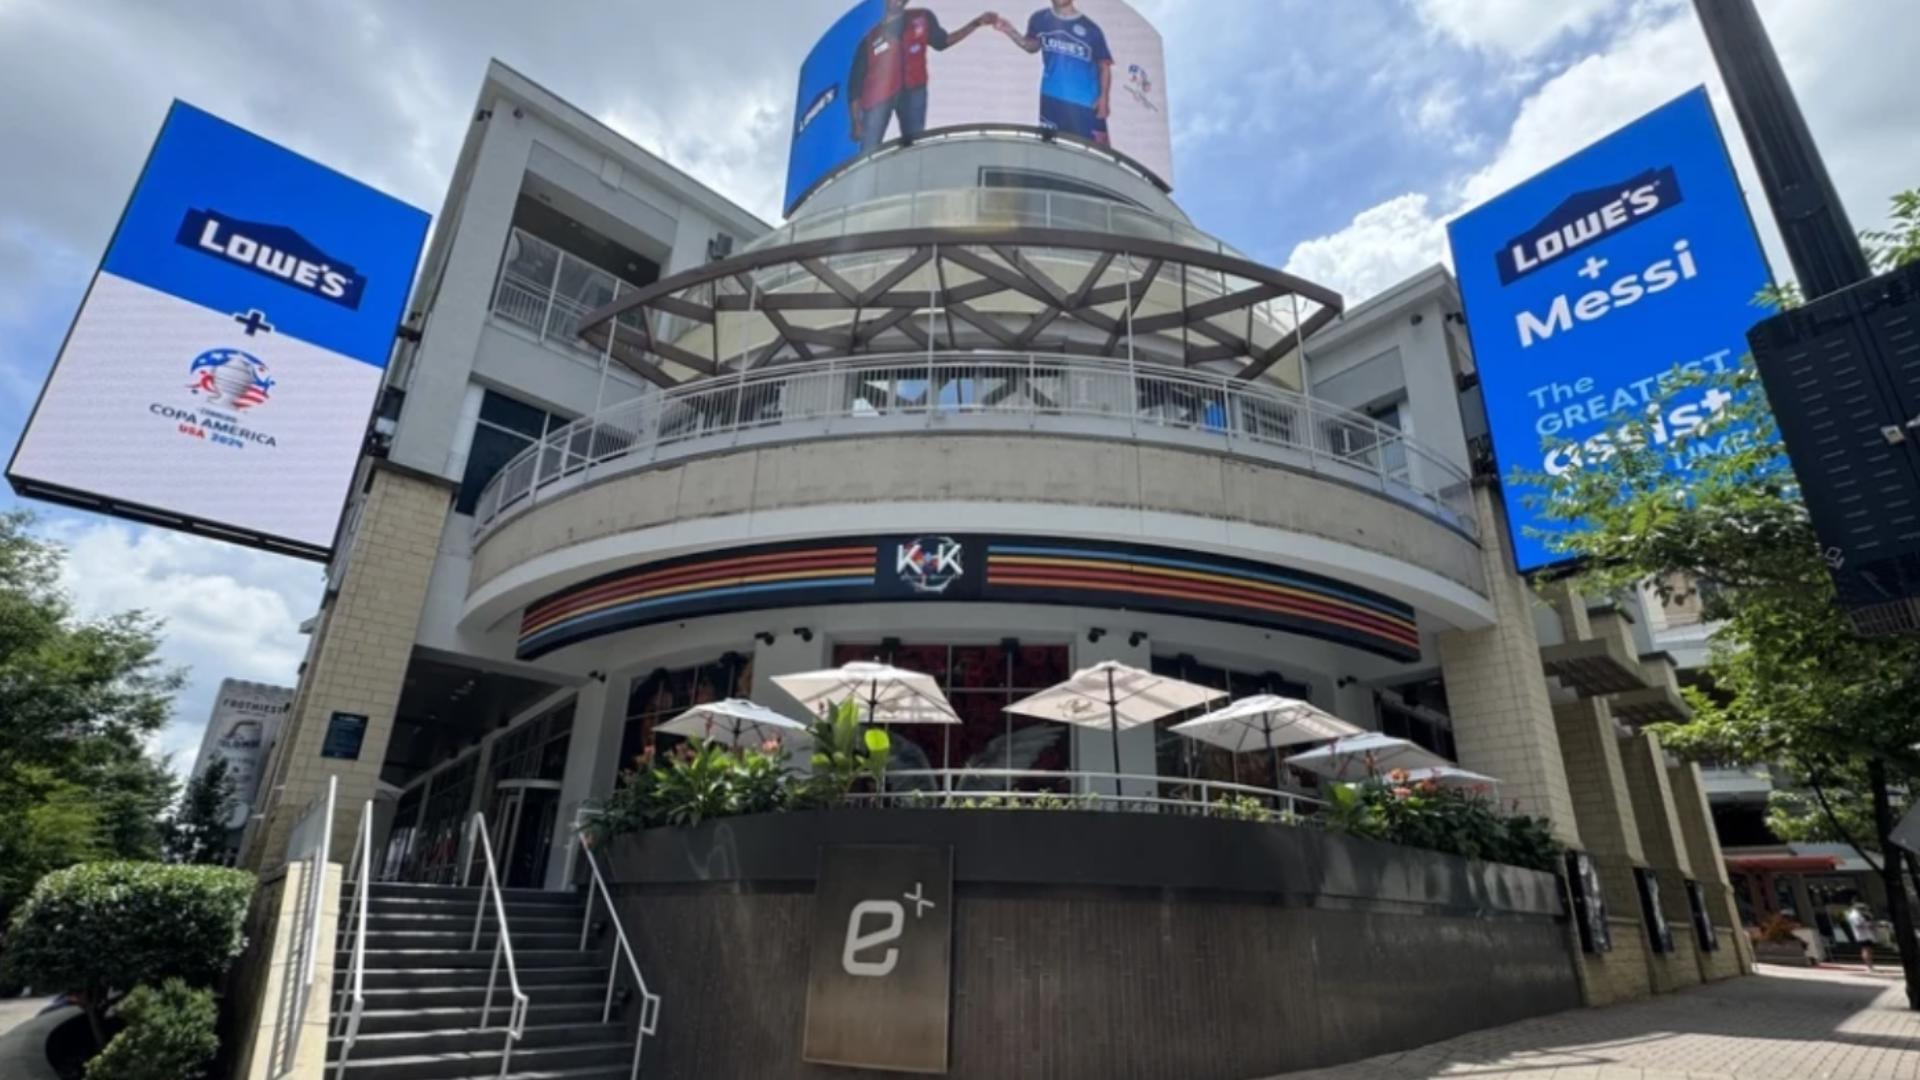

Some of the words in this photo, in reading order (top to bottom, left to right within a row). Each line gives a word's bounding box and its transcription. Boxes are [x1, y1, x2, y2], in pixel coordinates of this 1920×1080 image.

[199, 218, 348, 299] LOWE'S
[1512, 184, 1660, 274] LOWE'S
[1515, 238, 1698, 349] Messi
[149, 403, 197, 424] COPA
[178, 423, 205, 439] USA
[1528, 376, 1595, 410] The
[1535, 349, 1731, 436] GREATEST
